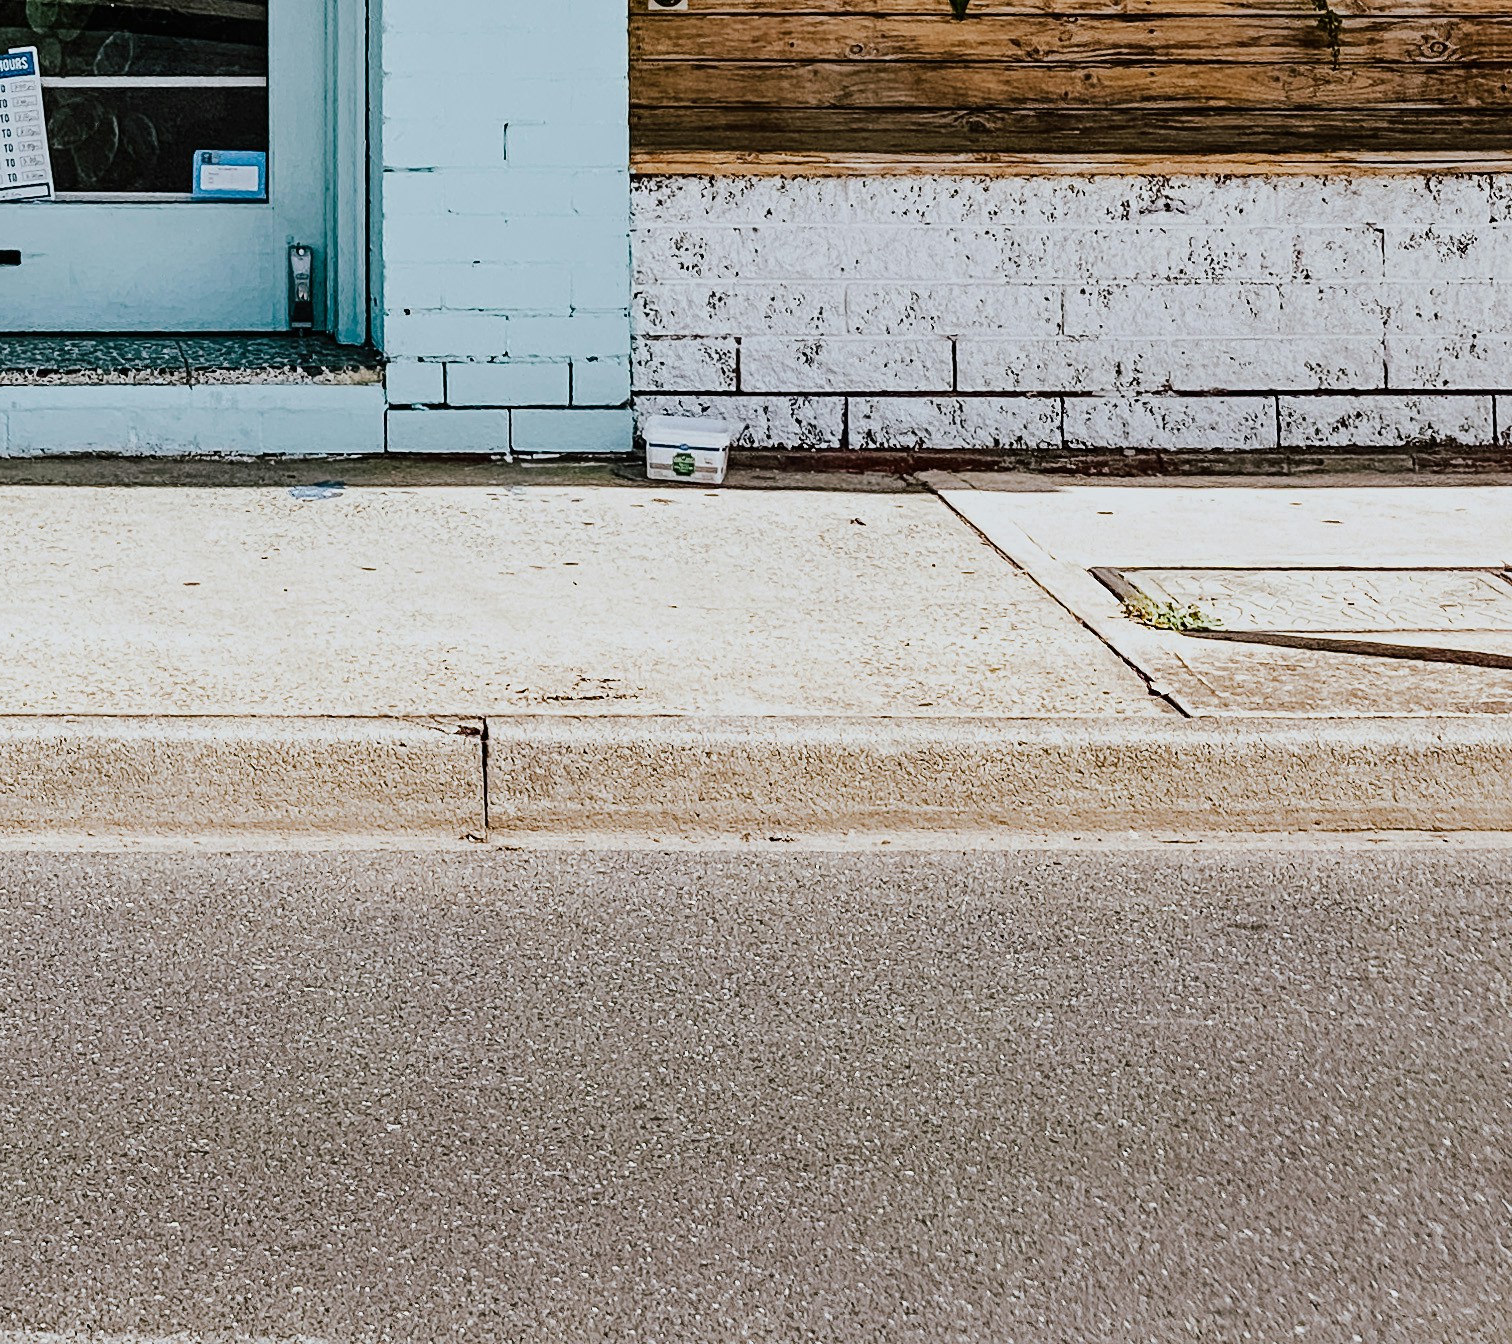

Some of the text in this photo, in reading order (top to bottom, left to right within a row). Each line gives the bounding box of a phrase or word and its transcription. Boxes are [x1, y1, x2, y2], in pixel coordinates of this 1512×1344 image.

[0, 114, 10, 123] TO
[1, 129, 12, 138] TO
[3, 144, 14, 153] TO
[6, 158, 16, 167] TO
[7, 173, 17, 182] TO
